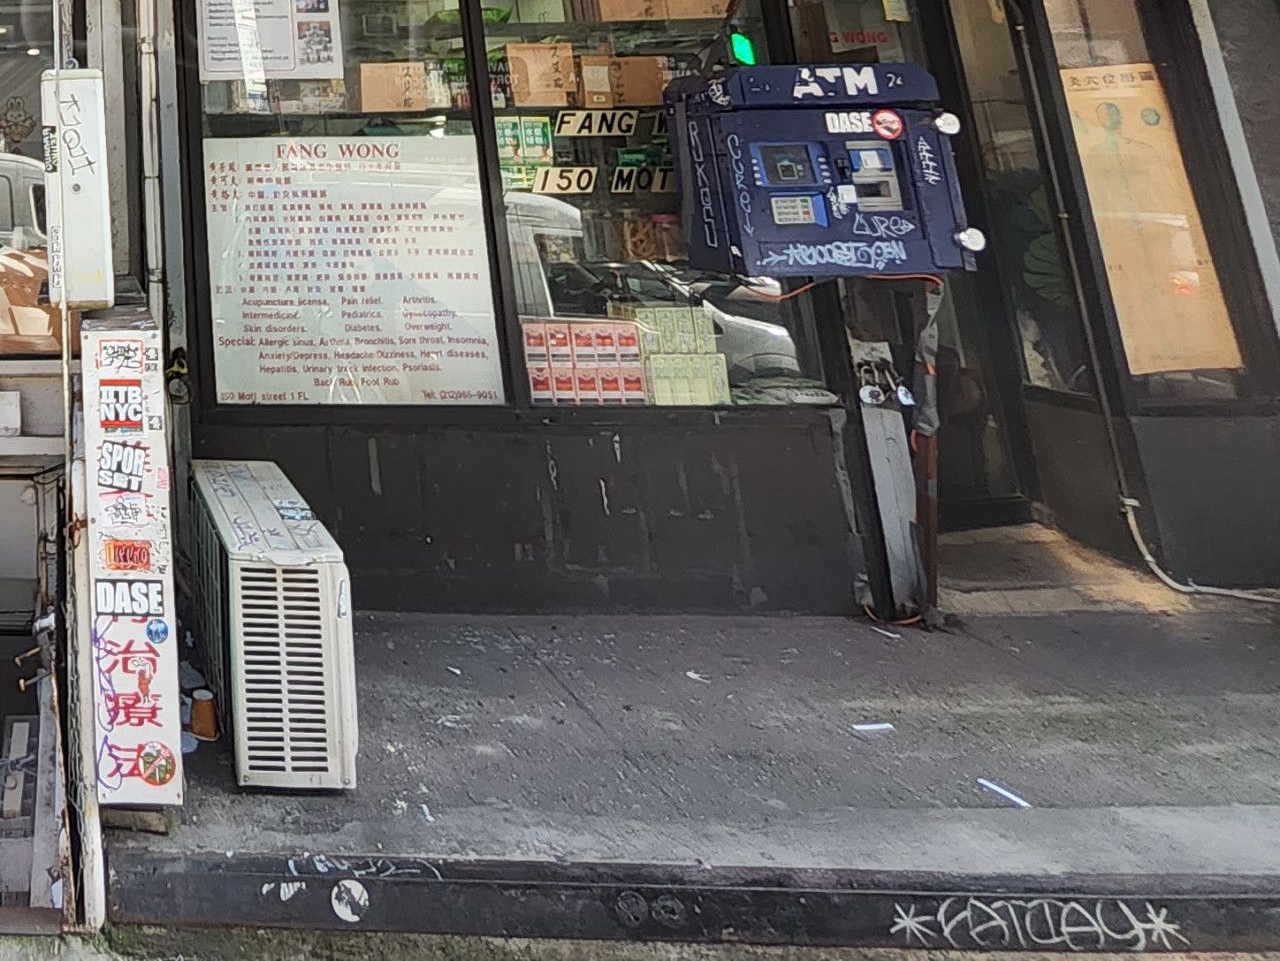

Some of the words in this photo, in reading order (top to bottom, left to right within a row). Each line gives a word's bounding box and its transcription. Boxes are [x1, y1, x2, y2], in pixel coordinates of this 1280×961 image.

[842, 29, 888, 44] WONG
[793, 66, 878, 98] ATM
[556, 112, 635, 135] FANG
[825, 111, 873, 134] DASE
[275, 143, 328, 159] FANG
[338, 143, 400, 159] WONG
[540, 169, 594, 190] 150
[341, 296, 360, 305] Pain
[243, 324, 262, 333] Skin
[100, 403, 143, 422] NYC
[97, 581, 163, 615] DASE
[103, 616, 175, 779] 治療法
